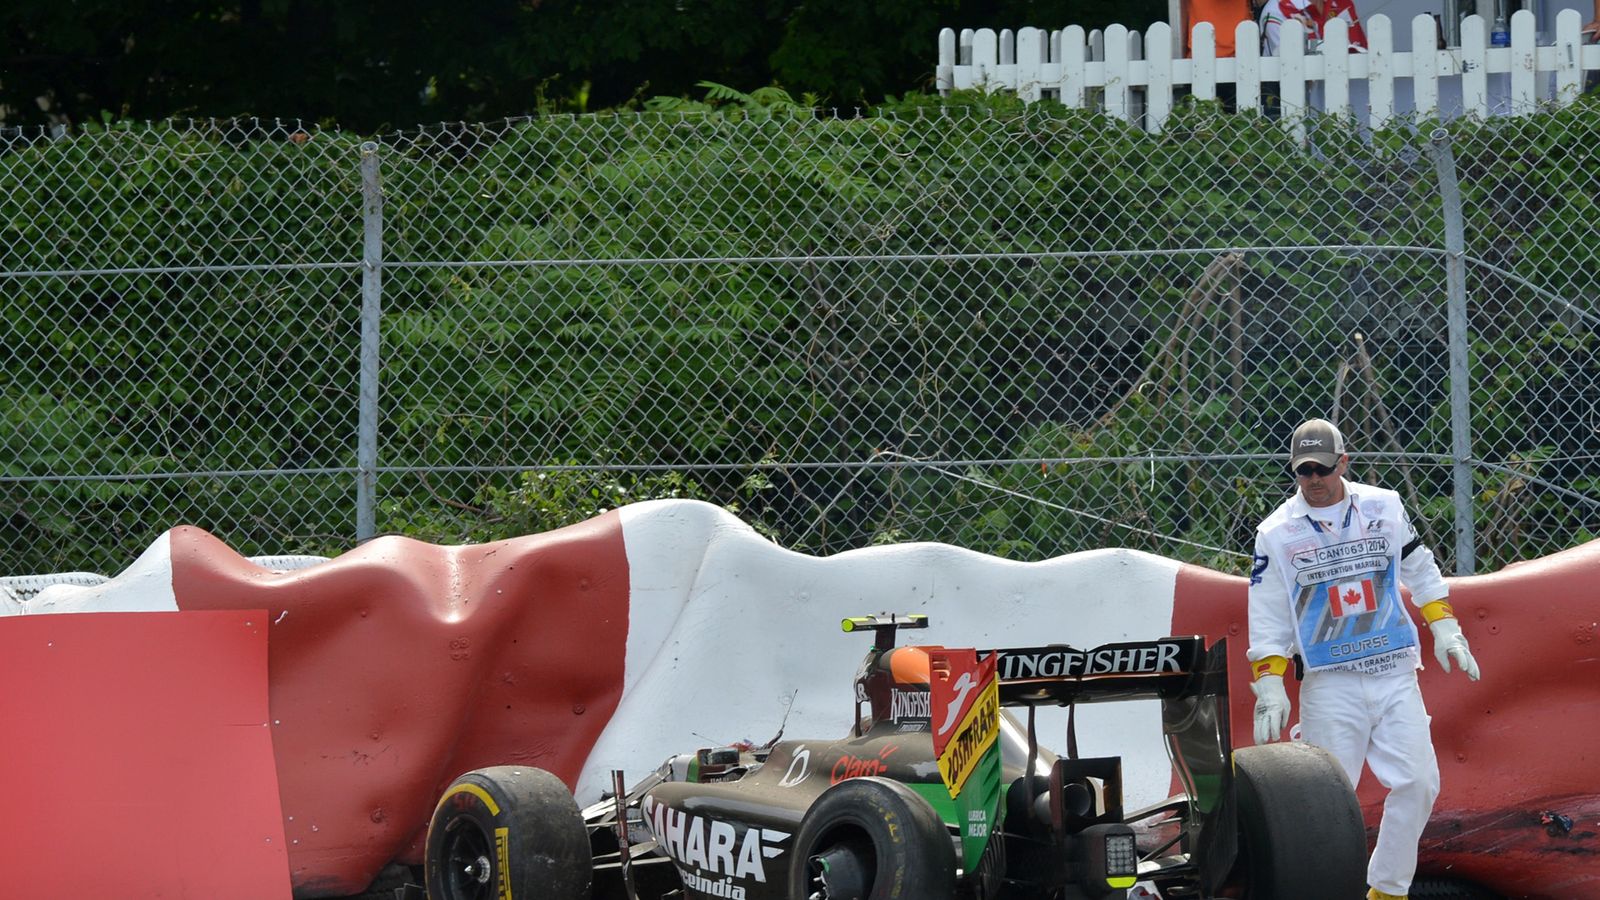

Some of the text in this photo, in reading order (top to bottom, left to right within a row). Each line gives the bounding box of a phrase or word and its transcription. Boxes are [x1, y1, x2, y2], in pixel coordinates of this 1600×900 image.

[1368, 540, 1386, 552] 2014
[1306, 565, 1354, 580] INTERVENTION
[1330, 635, 1389, 657] COURSE
[1364, 655, 1391, 668] GRAND
[890, 688, 932, 724] KINGFISH
[643, 795, 767, 883] SAHARA
